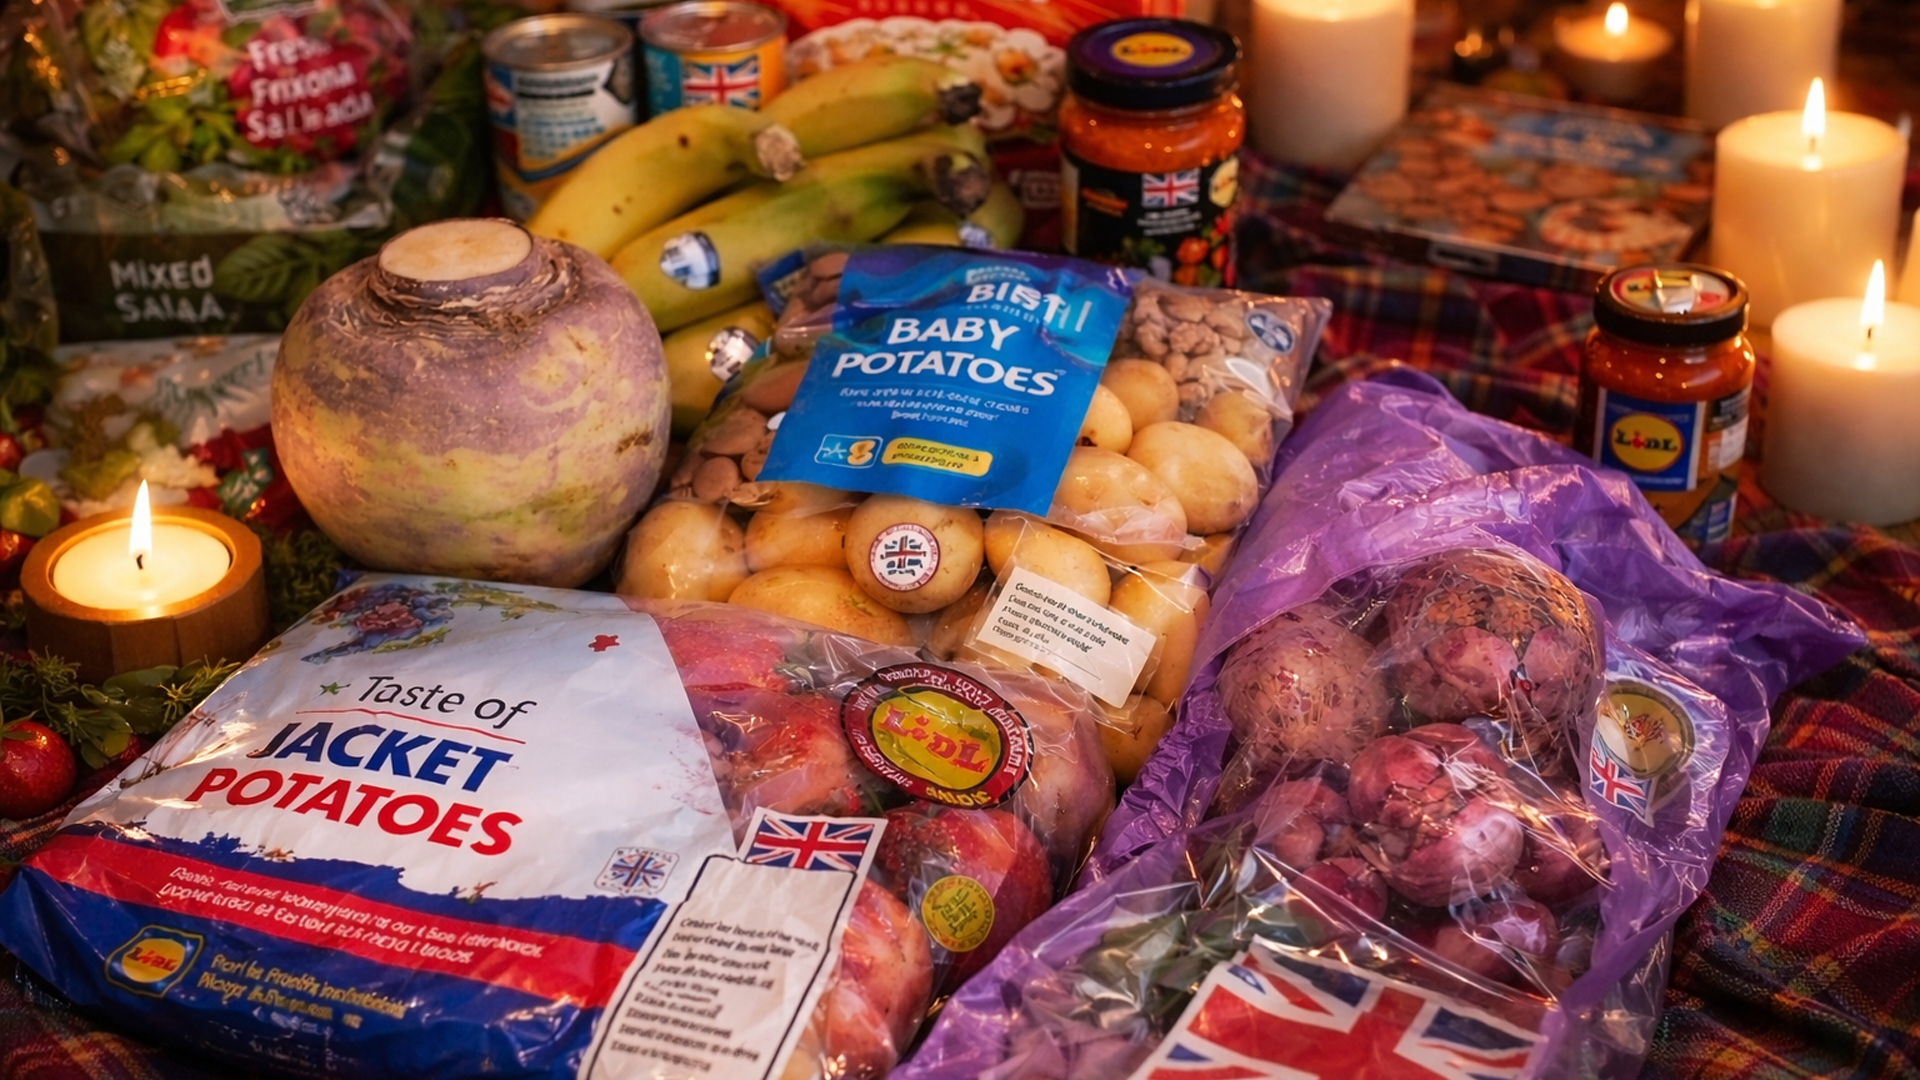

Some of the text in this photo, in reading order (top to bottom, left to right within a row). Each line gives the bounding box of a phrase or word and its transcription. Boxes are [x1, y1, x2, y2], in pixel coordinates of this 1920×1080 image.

[887, 317, 1020, 351] BABY
[831, 351, 1060, 396] POTATOES
[358, 676, 537, 729] Taste of
[246, 722, 514, 792] JACKET
[184, 767, 524, 856] POTATOES
